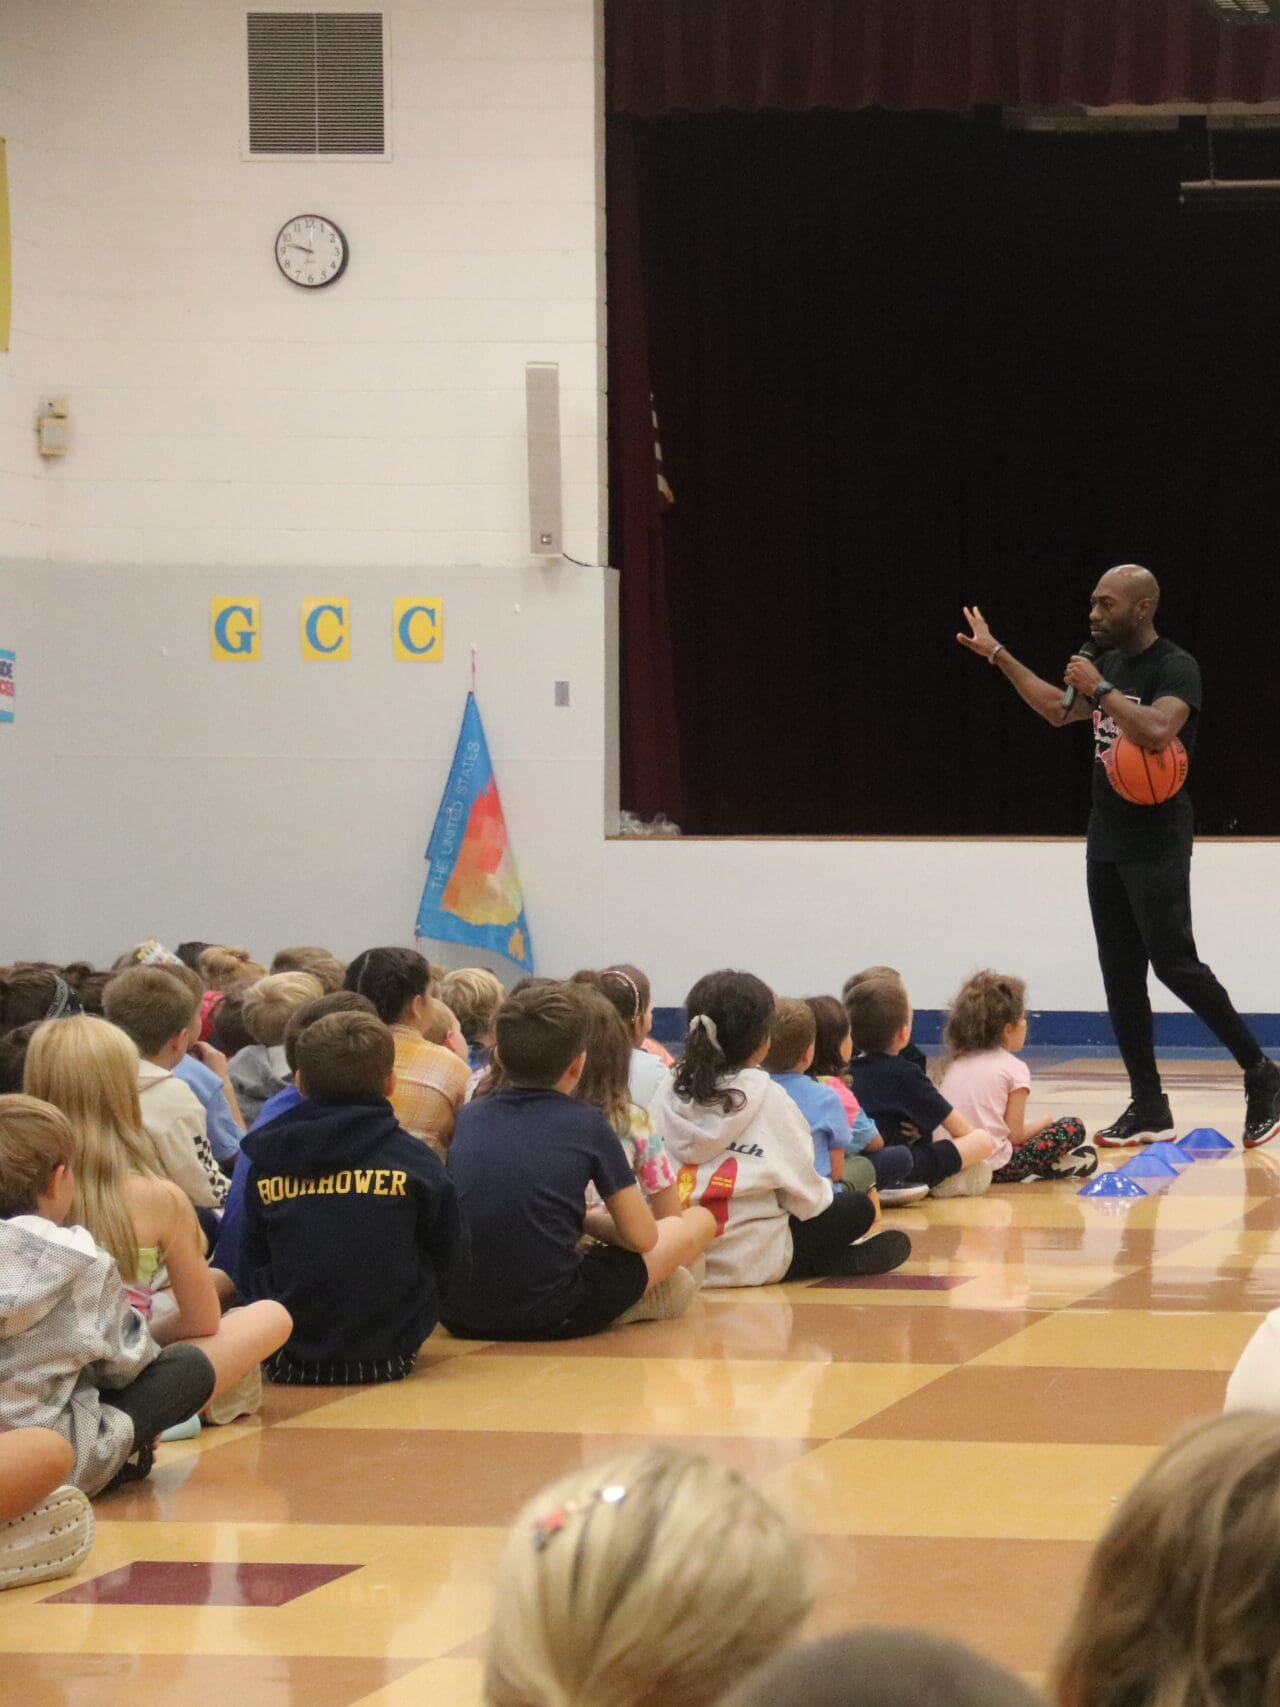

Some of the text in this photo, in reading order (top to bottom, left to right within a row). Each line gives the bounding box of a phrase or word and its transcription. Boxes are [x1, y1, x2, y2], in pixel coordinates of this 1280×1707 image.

[329, 233, 336, 243] 2
[214, 605, 436, 654] G C C
[430, 742, 480, 891] THE UNITED STATES
[257, 1169, 407, 1205] BOOMHOWER
